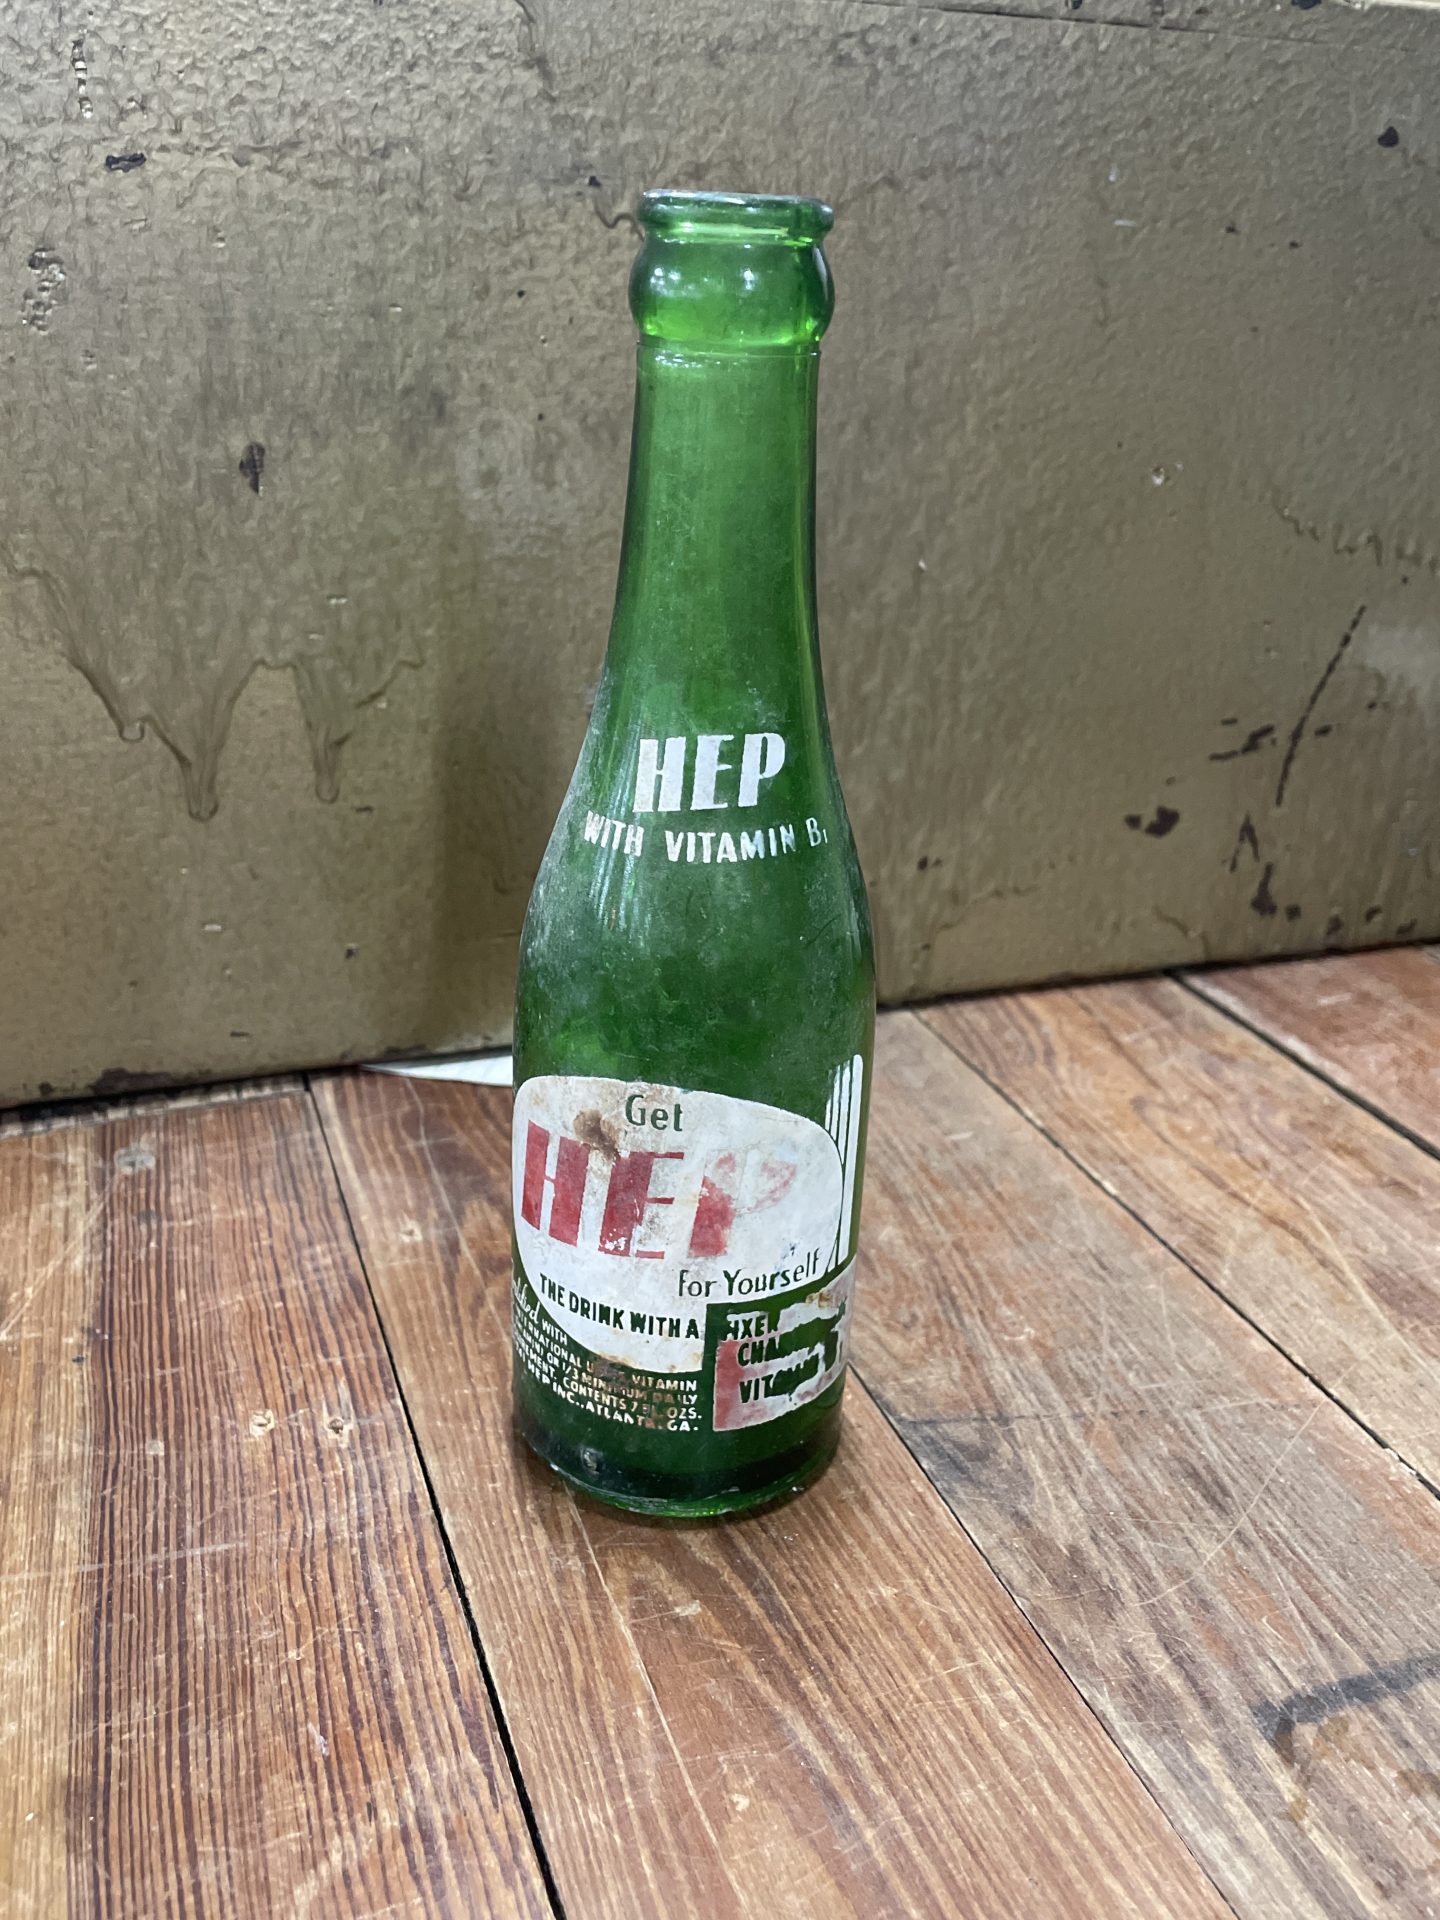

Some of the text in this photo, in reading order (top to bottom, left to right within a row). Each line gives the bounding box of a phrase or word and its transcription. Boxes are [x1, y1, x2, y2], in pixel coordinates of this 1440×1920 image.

[632, 732, 786, 813] HEP
[584, 810, 645, 857] WITH
[665, 824, 797, 864] VITAMIN
[625, 1095, 683, 1132] Get
[521, 1119, 798, 1260] HEP
[722, 1248, 823, 1296] Yourself
[540, 1273, 699, 1340] THE DRINK WITH A
[542, 1318, 568, 1346] WITH
[546, 1353, 560, 1370] OR
[562, 1363, 579, 1380] 1/3
[581, 1372, 648, 1400] MINUM
[563, 1376, 626, 1410] CONTENTS
[667, 1406, 702, 1420] OZS.
[632, 1373, 697, 1392] VITAMIN
[667, 1419, 699, 1432] GA.
